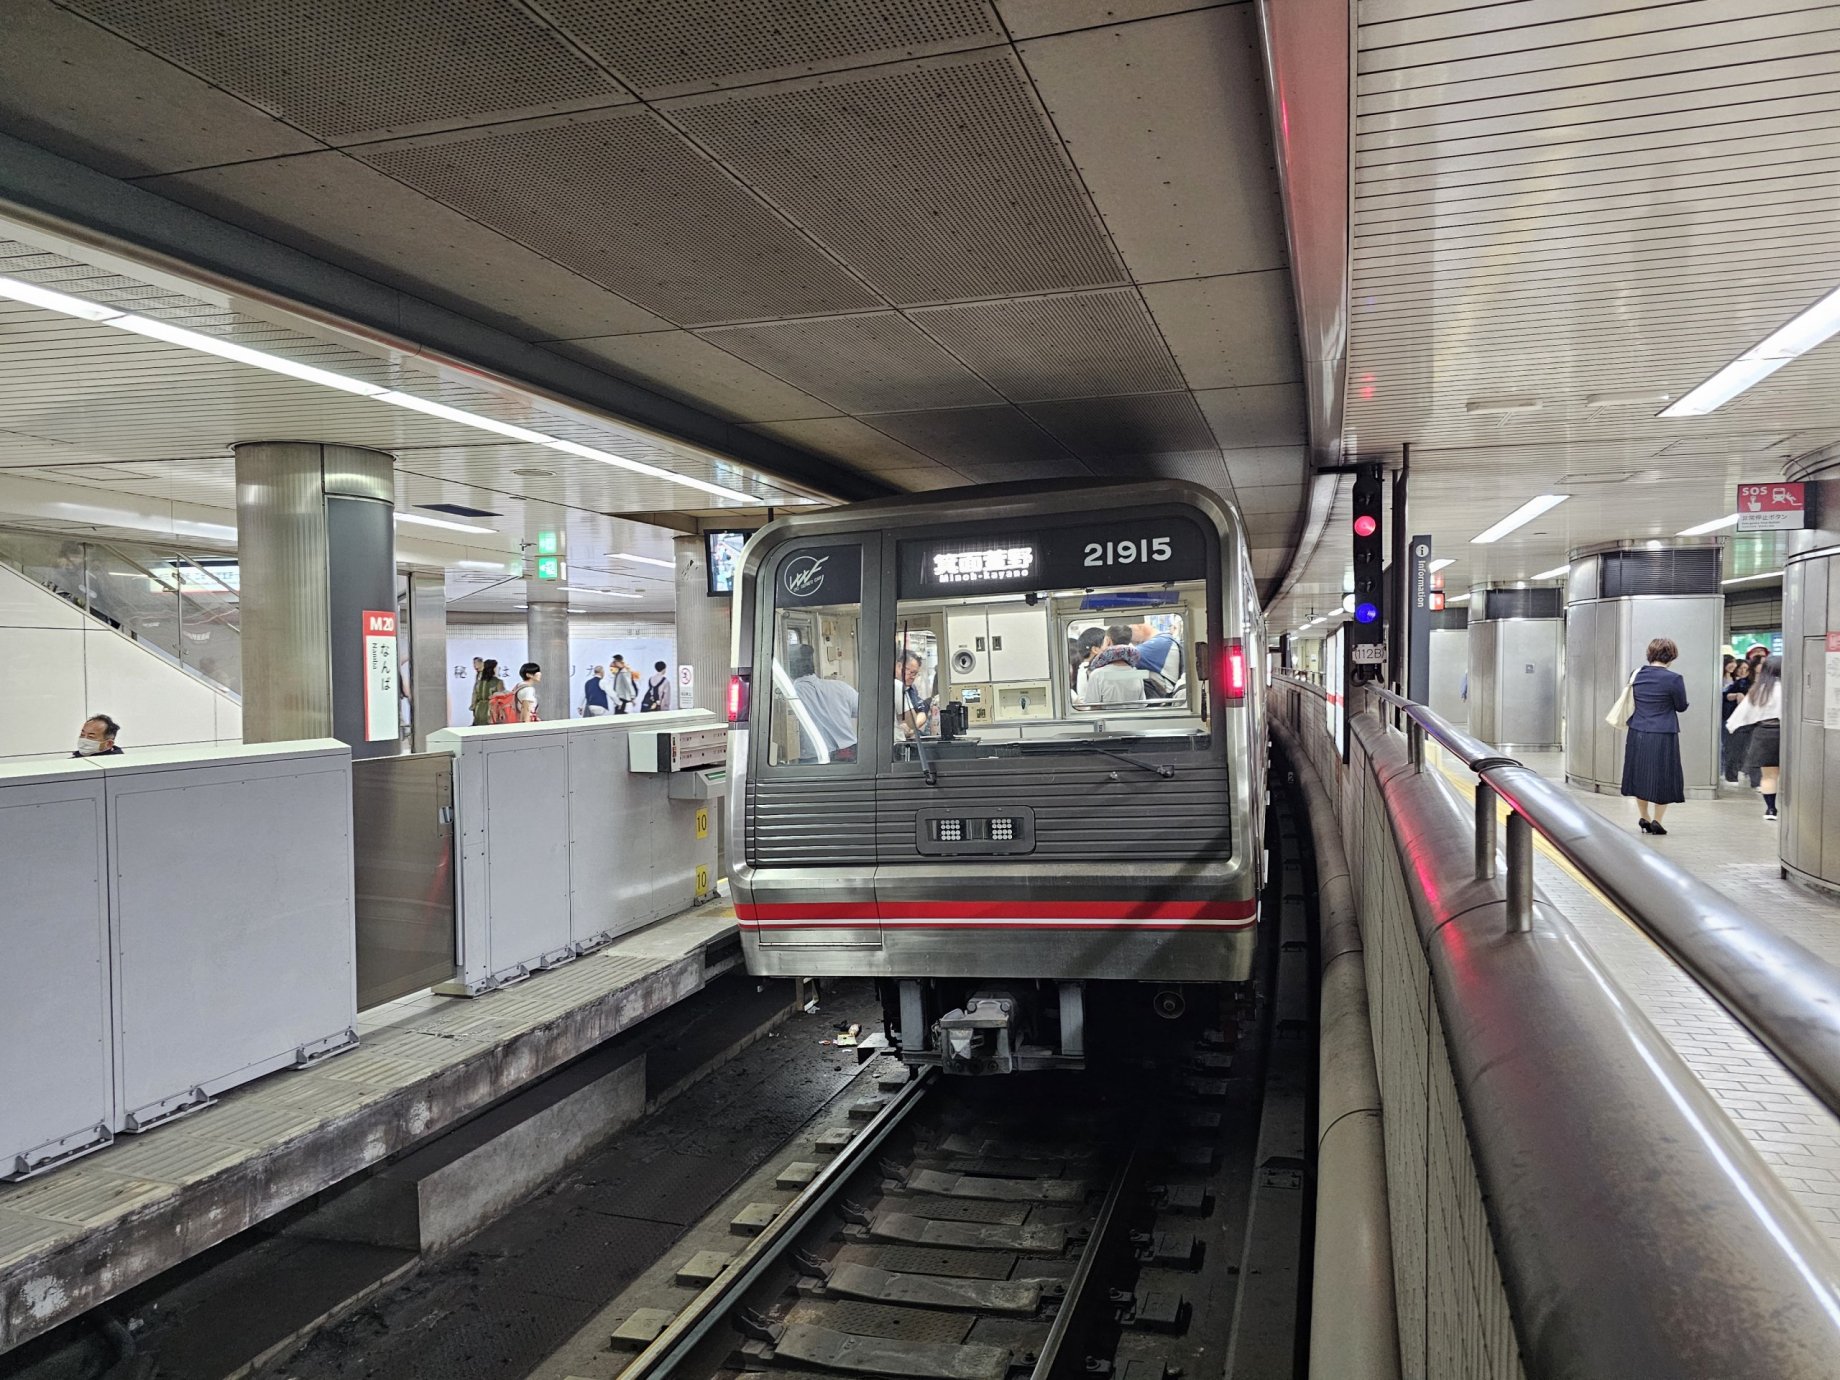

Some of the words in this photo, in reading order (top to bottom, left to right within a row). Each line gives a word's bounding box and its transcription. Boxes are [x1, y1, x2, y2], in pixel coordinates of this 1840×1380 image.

[1742, 486, 1768, 496] SOS
[1083, 537, 1172, 567] 21915
[1417, 560, 1426, 608] Information
[369, 616, 395, 631] M20
[380, 643, 391, 691] なんば
[696, 814, 707, 832] 10
[696, 871, 707, 889] 10
